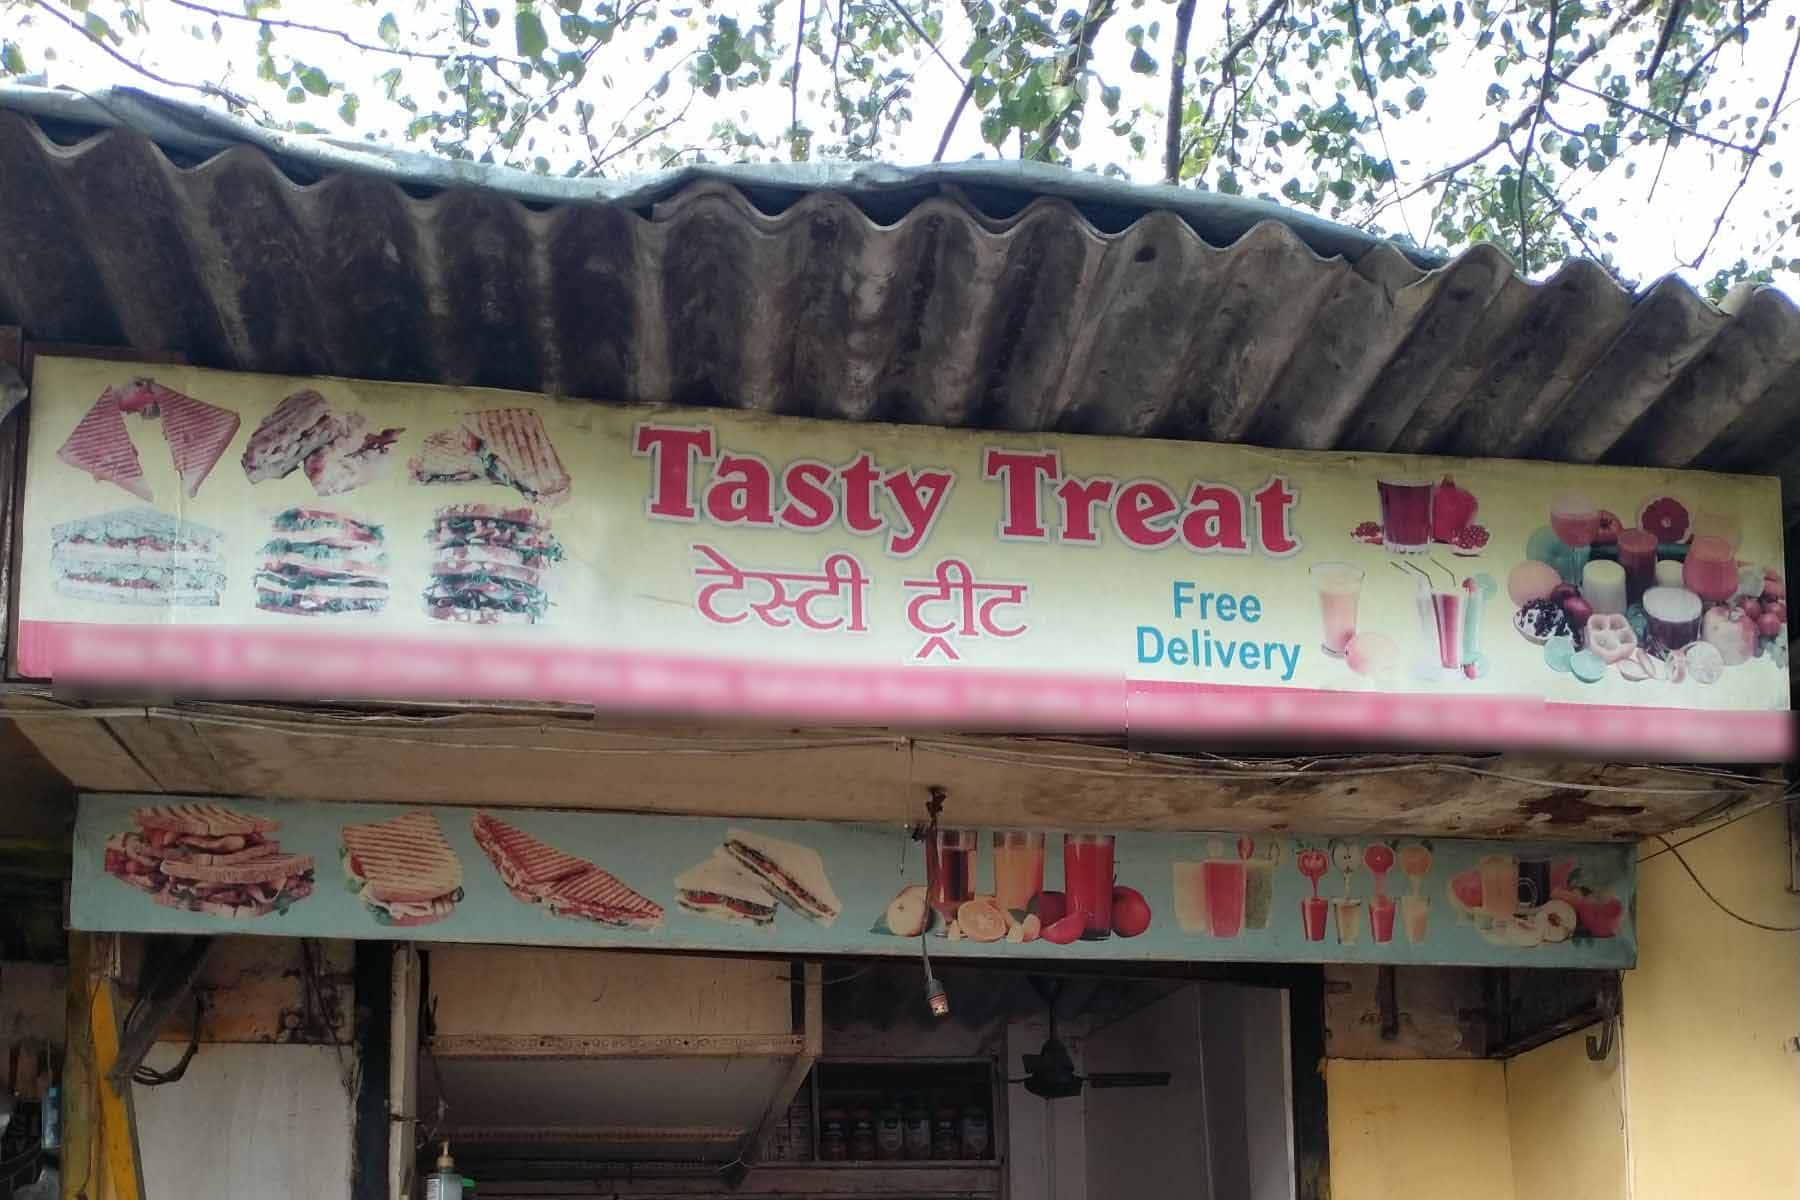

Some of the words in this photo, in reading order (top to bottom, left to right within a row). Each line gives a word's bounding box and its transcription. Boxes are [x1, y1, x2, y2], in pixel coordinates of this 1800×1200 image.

[636, 426, 954, 553] Tasty
[985, 449, 1298, 553] Treat
[692, 544, 870, 632] टेस्टी
[903, 559, 1028, 660] ट्रीट
[1172, 582, 1262, 623] Free
[1136, 626, 1302, 681] Delivery
